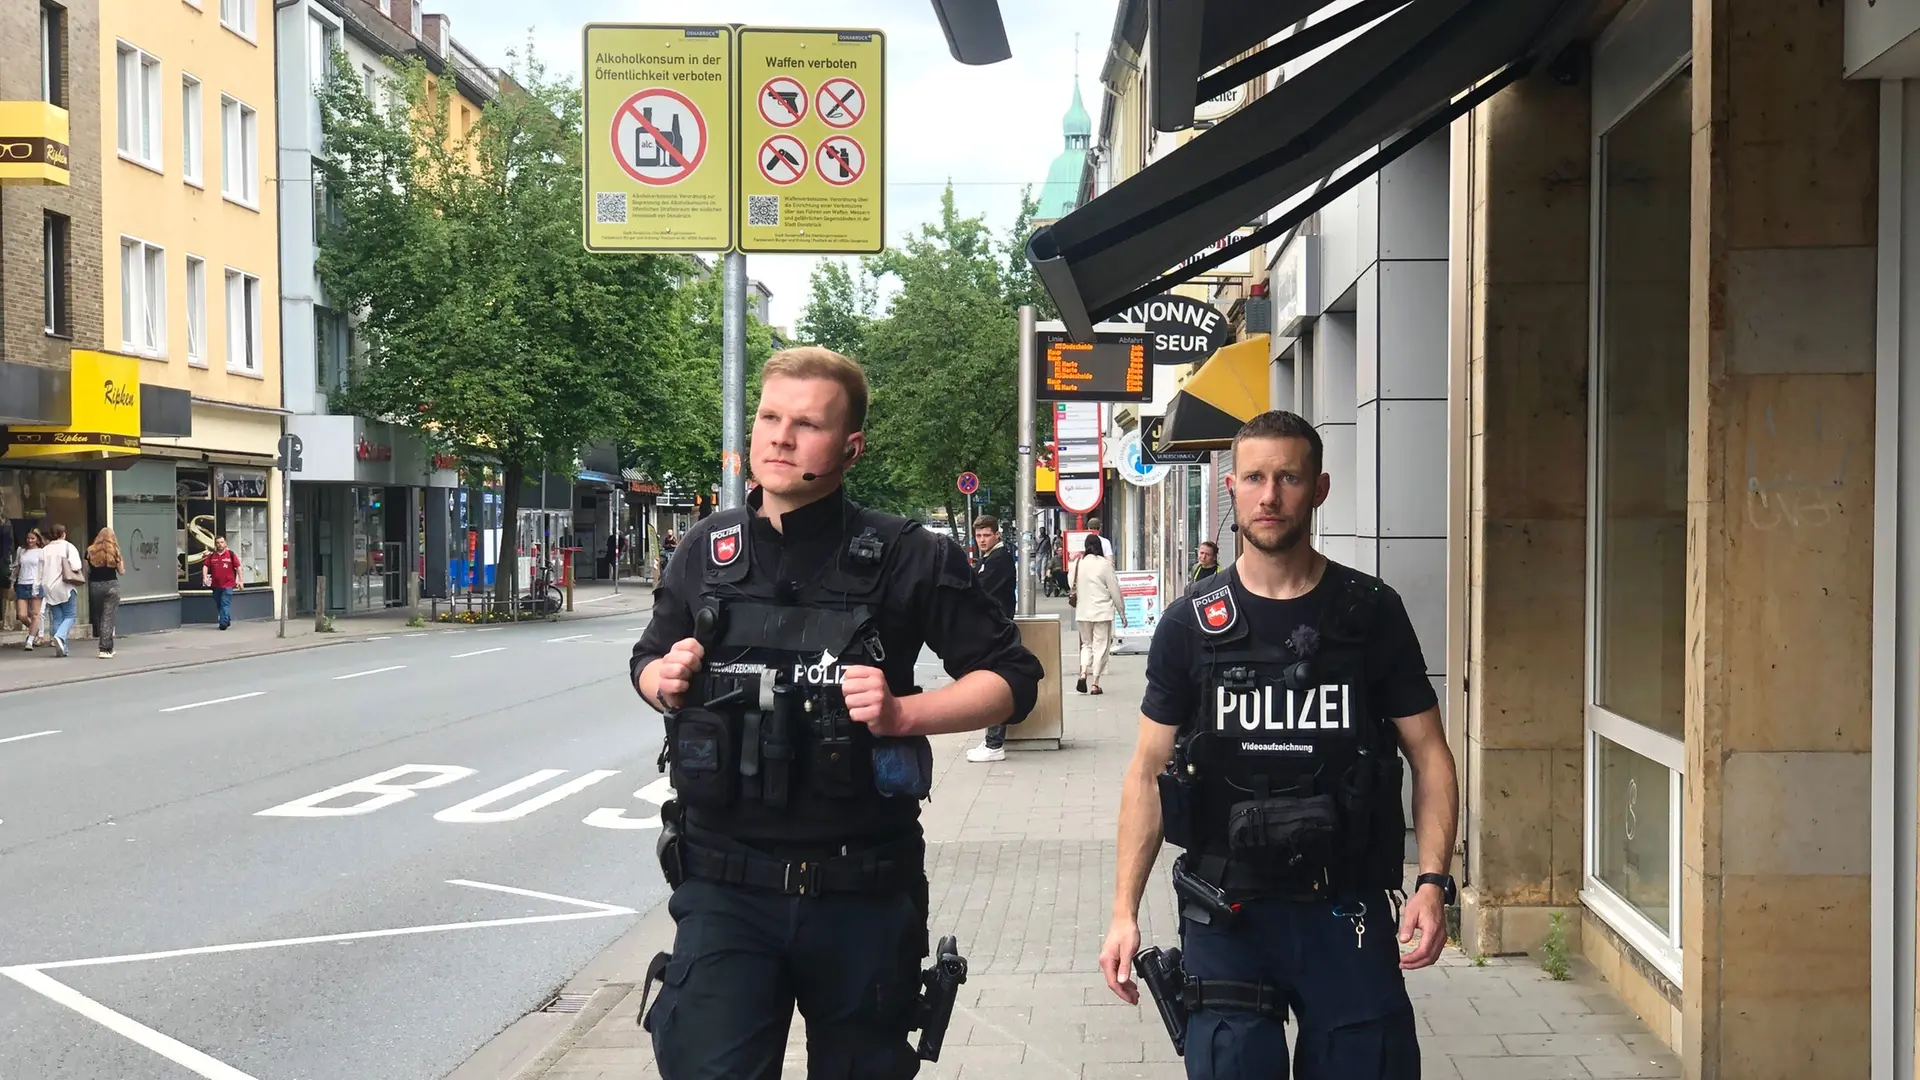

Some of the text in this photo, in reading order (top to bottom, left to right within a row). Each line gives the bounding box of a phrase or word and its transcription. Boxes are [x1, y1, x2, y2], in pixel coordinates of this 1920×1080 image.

[595, 53, 721, 65] Alkoholkonsum in der
[765, 56, 857, 69] Waffen verboten
[595, 66, 722, 81] Öffentlichkeit verboten
[1118, 302, 1220, 334] YVONNE
[1047, 335, 1064, 343] Linie
[1118, 336, 1143, 344] Abfahrt
[1155, 334, 1208, 352] SEUR
[104, 380, 134, 410] Ripken
[53, 432, 89, 444] Ripken
[712, 526, 740, 539] POLIZEI
[1195, 588, 1229, 607] POLIZEI
[793, 663, 850, 684] POLIZ
[1216, 684, 1350, 730] POLIZEI
[1241, 742, 1313, 753] Videoaufzeichnung
[252, 763, 677, 830] BUS
